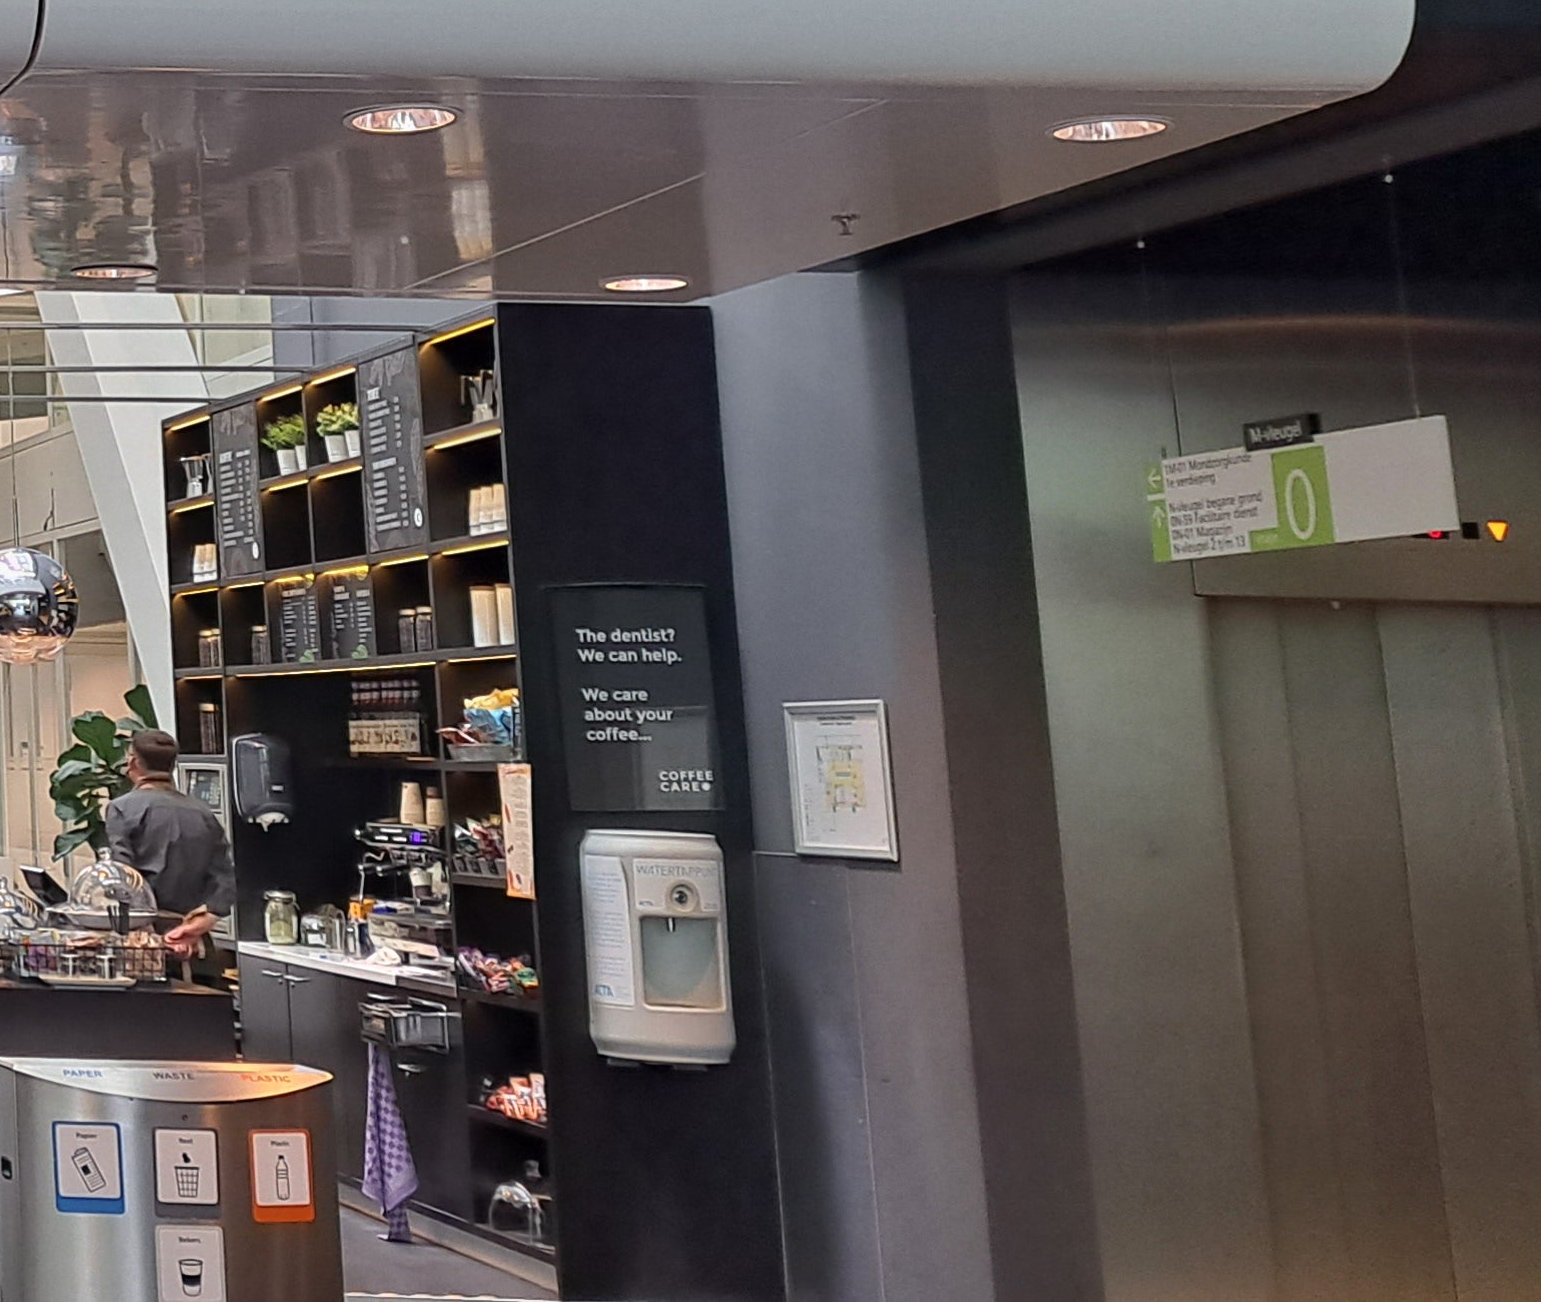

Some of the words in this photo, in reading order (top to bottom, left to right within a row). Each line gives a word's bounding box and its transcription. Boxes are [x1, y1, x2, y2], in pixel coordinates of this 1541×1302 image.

[1238, 490, 1263, 508] grond
[1285, 468, 1316, 541] 0
[576, 628, 606, 643] The
[610, 628, 675, 643] dentist?
[577, 648, 605, 662] We
[609, 651, 638, 662] can
[641, 648, 682, 665] help.
[581, 688, 609, 701] We
[612, 690, 648, 701] care
[584, 708, 632, 721] about
[636, 710, 673, 724] your
[586, 727, 652, 741] coffee...
[659, 770, 714, 781] COFFEE
[660, 782, 701, 792] CARE
[63, 1069, 103, 1078] PAPER
[152, 1071, 195, 1080] WASTE
[241, 1073, 291, 1083] PLASTIC
